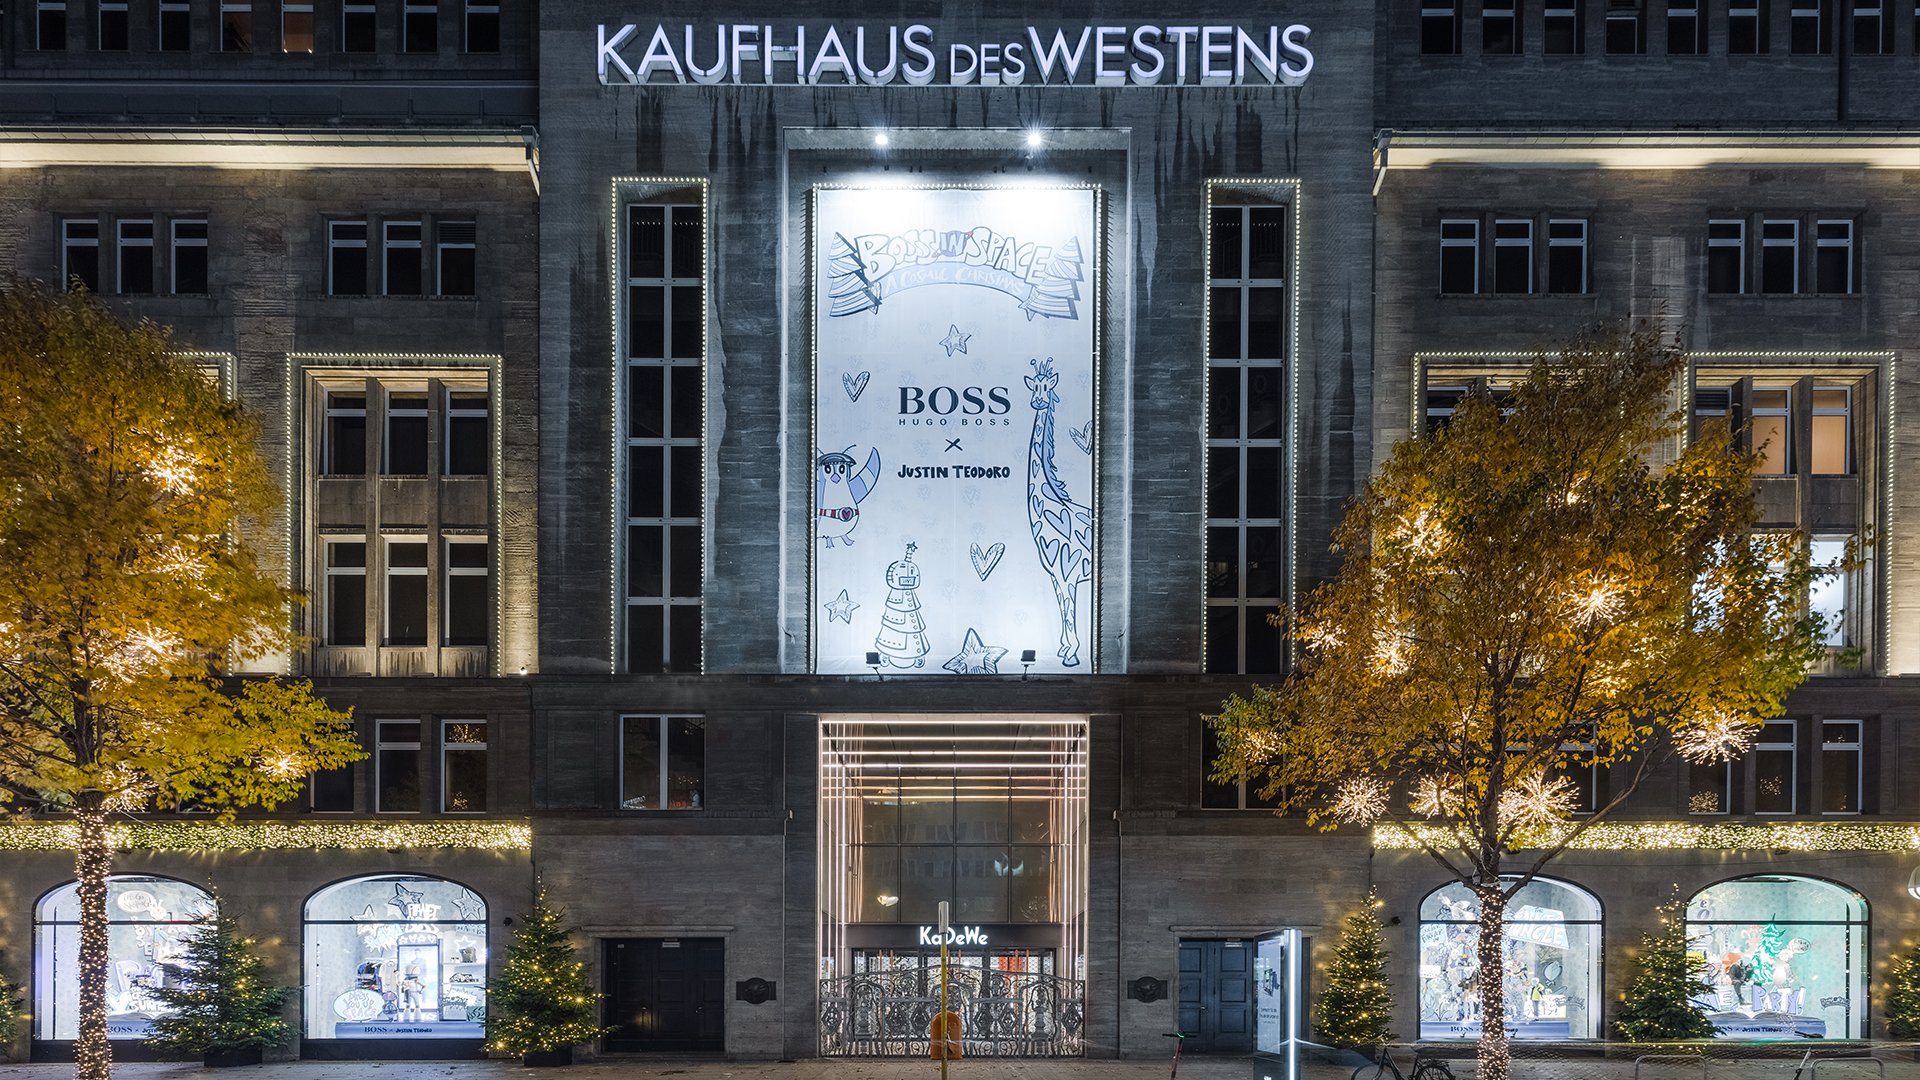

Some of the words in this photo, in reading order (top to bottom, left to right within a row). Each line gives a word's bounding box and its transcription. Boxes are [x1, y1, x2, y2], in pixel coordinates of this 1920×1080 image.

[598, 24, 937, 83] KAUFHAUS
[950, 42, 1026, 83] DES
[1027, 24, 1315, 83] WESTENS
[854, 228, 936, 282] BOSS
[939, 230, 966, 257] IN
[964, 226, 1052, 286] SPACE
[884, 274, 898, 294] A
[901, 267, 949, 287] COSMIC
[954, 266, 1025, 296] CHRISTMAS
[898, 386, 1011, 415] BOSS
[899, 418, 947, 426] HUGO
[961, 418, 1010, 426] BOSS
[897, 464, 949, 479] JUSTIN
[952, 465, 1010, 479] TEODORO
[408, 903, 441, 919] PLANET
[920, 926, 989, 945] KaDeWe
[1753, 984, 1806, 1015] PARTY!
